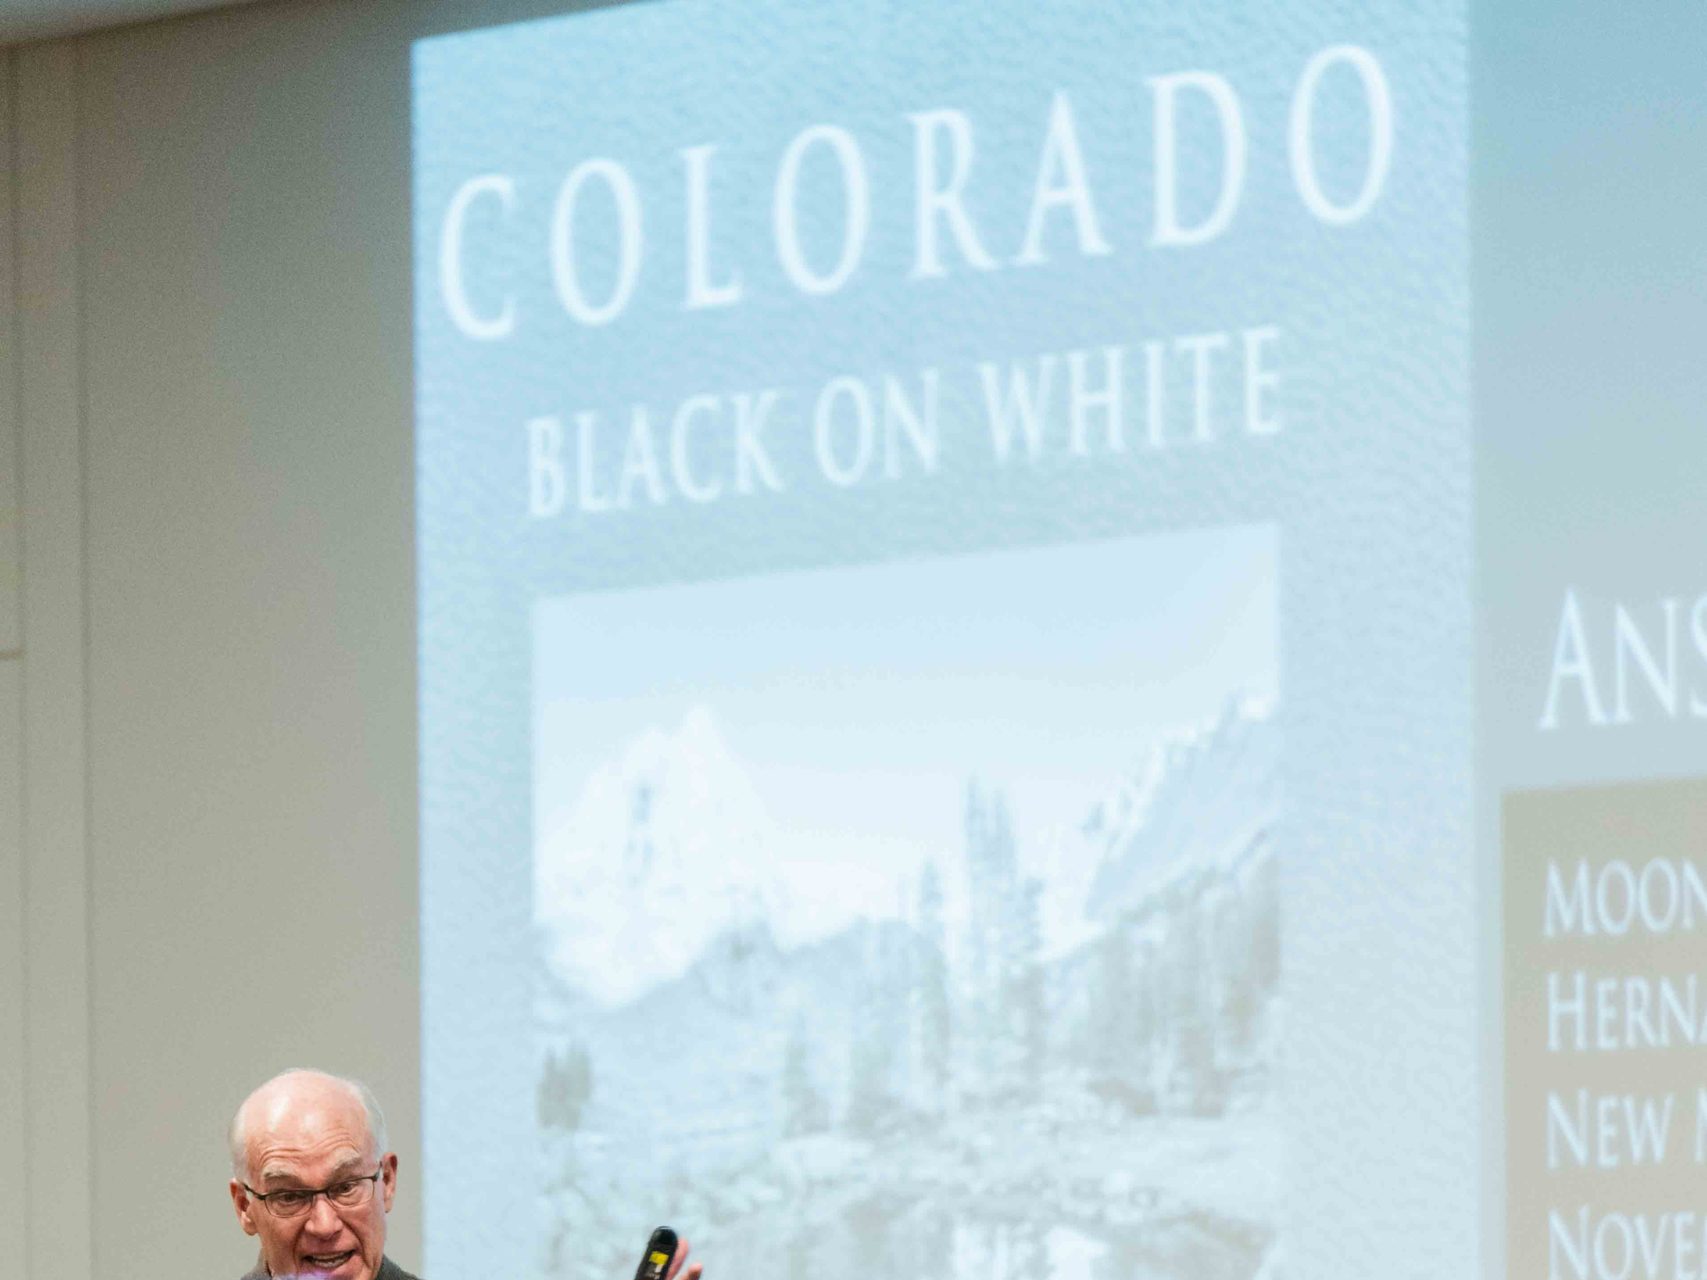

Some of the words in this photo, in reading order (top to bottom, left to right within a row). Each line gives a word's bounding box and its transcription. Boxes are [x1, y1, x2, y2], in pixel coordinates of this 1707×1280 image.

[440, 44, 1394, 340] COLORADO
[526, 390, 786, 518] BLACK
[814, 368, 940, 487] ON
[977, 324, 1283, 465] WHITE
[1546, 969, 1707, 1052] HERN
[1546, 1087, 1674, 1170] NEW
